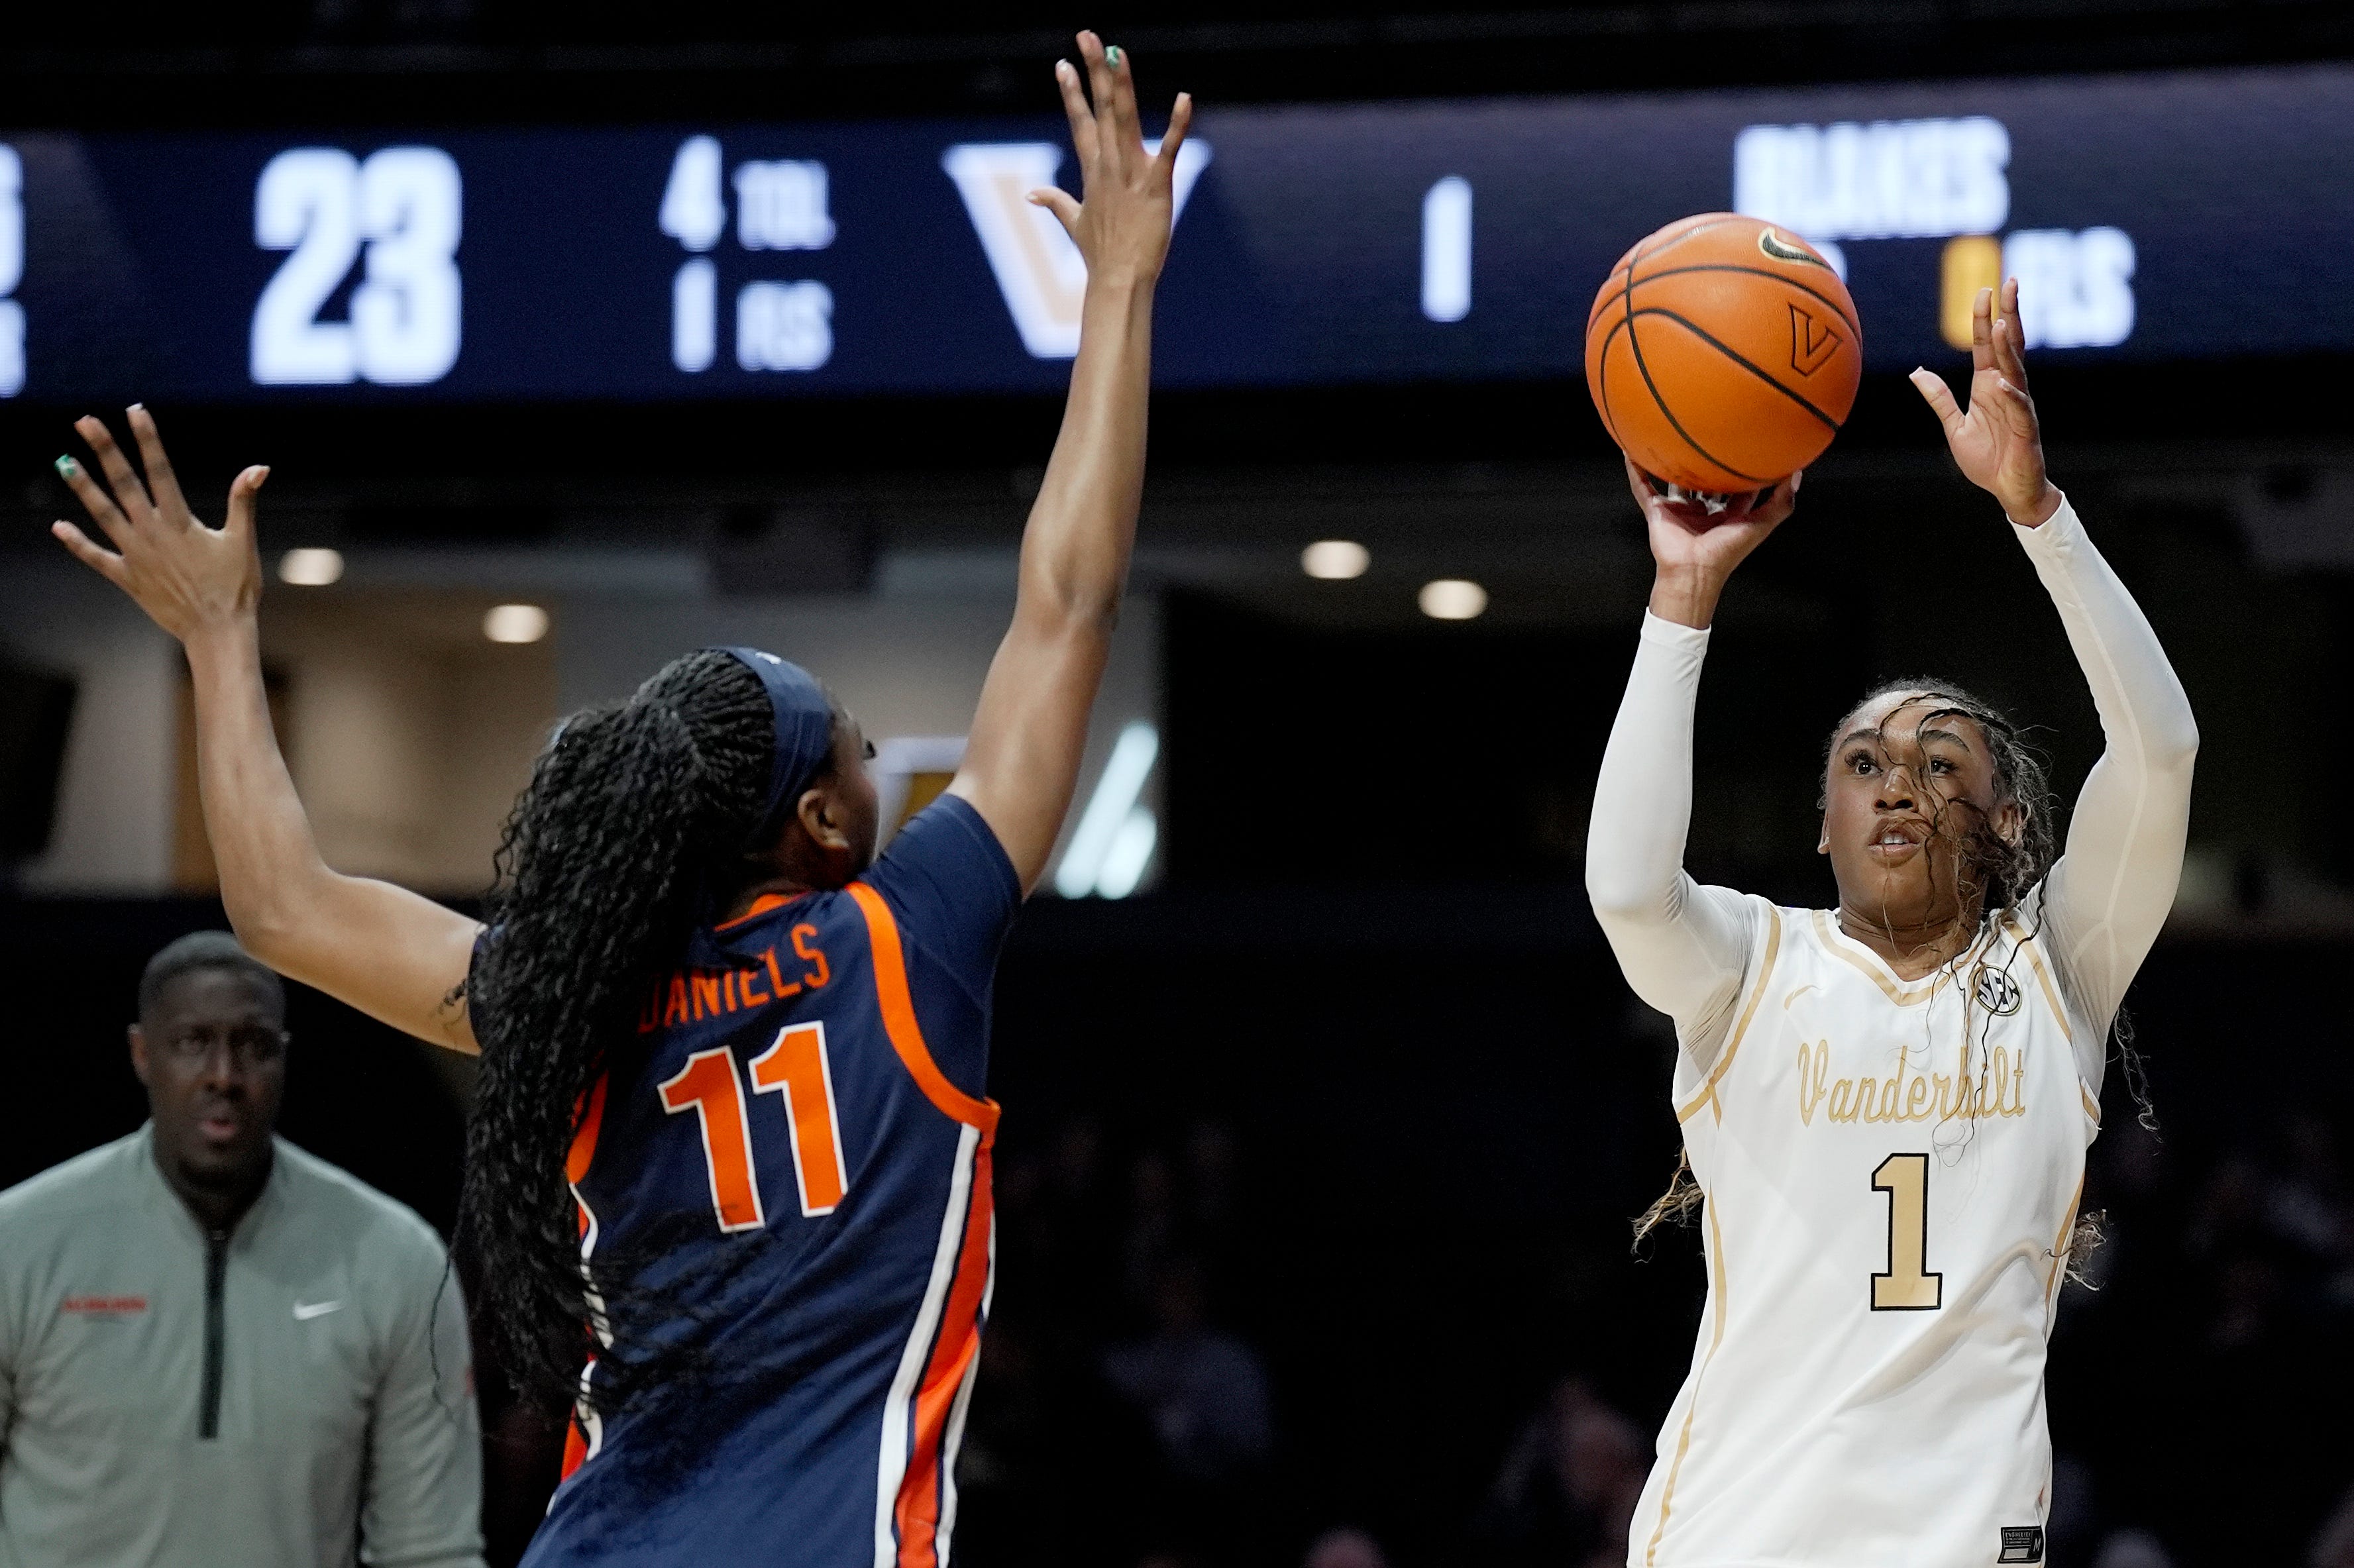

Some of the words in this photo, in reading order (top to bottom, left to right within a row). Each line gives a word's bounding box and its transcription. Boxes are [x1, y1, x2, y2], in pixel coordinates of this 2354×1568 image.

[660, 136, 723, 250] 4
[251, 146, 462, 384] 23
[1788, 302, 1843, 377] V
[657, 1019, 849, 1233] 11
[1798, 1039, 2026, 1127] Vanderbilt
[1871, 1153, 1943, 1311] 1
